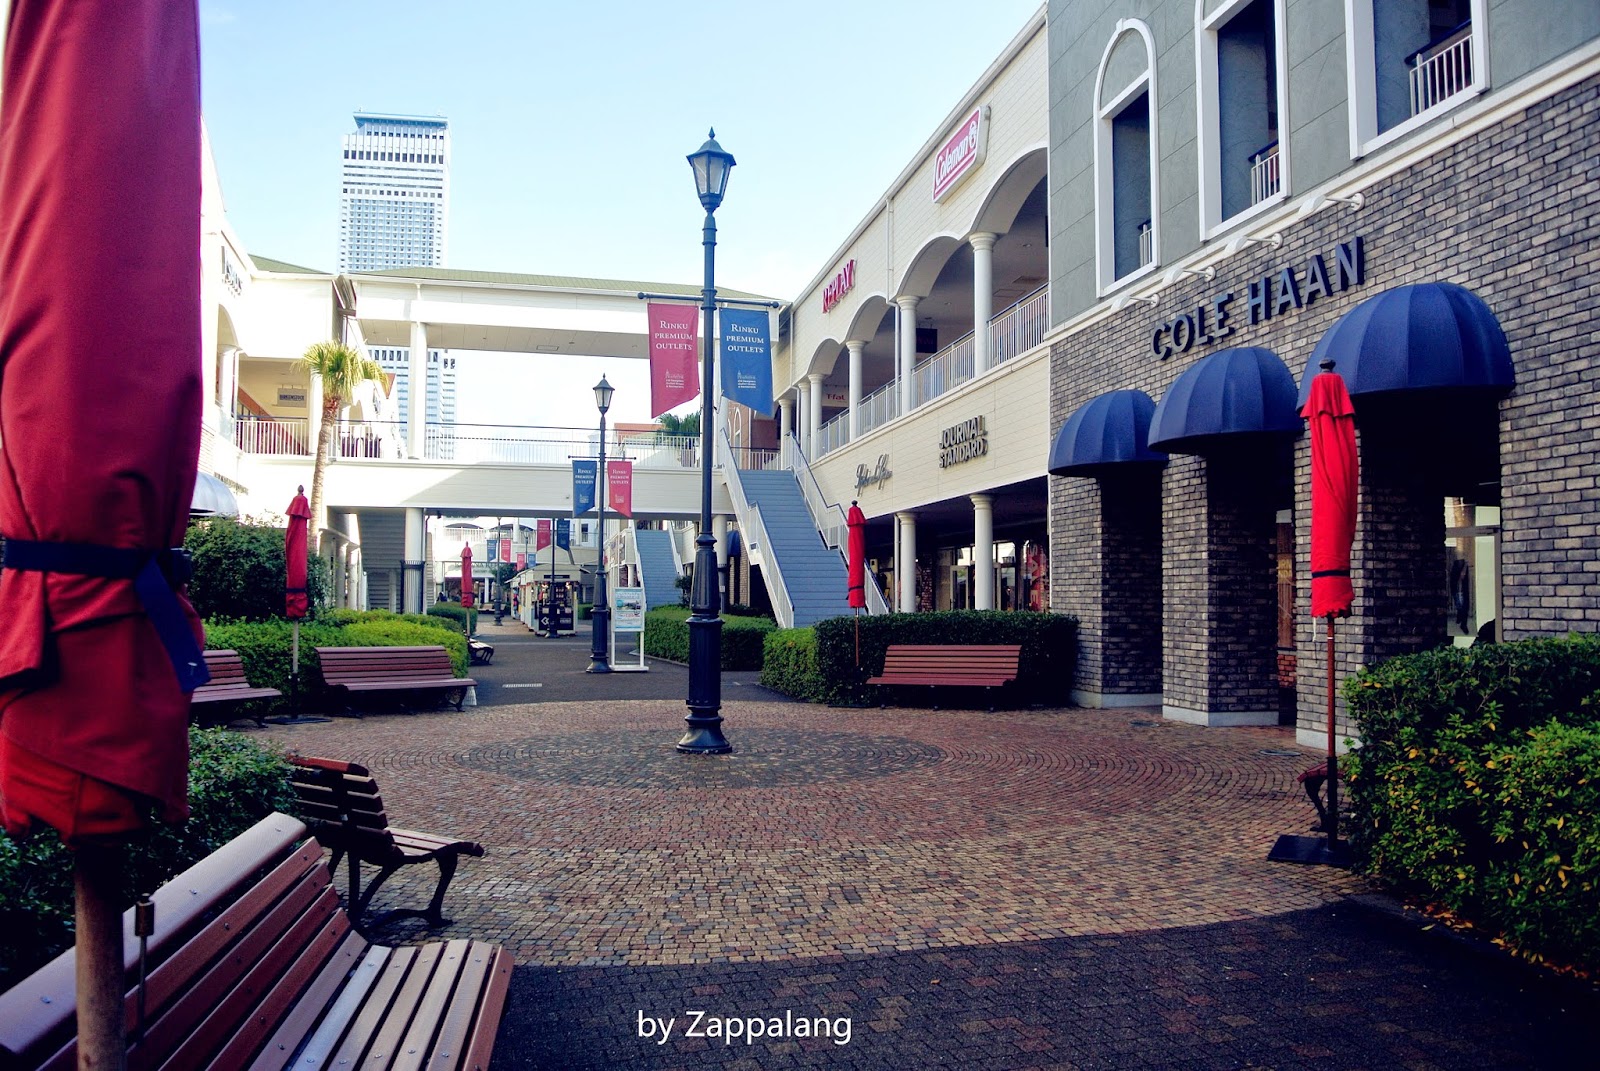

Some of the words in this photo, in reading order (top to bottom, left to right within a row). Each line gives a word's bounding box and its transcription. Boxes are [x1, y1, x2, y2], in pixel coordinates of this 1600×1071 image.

[935, 134, 970, 187] Coleman
[822, 258, 856, 314] REPLAY
[1151, 291, 1236, 361] COLE
[1247, 236, 1365, 326] HAAN
[659, 320, 689, 330] RINKU
[730, 323, 760, 334] RINKU
[654, 332, 693, 341] PREMIUM
[726, 335, 765, 344] PREMIUM
[655, 342, 693, 351] OUTLETS
[727, 344, 765, 354] OUTLETS
[938, 414, 988, 450] JOURNAL
[938, 437, 989, 469] STANDARD
